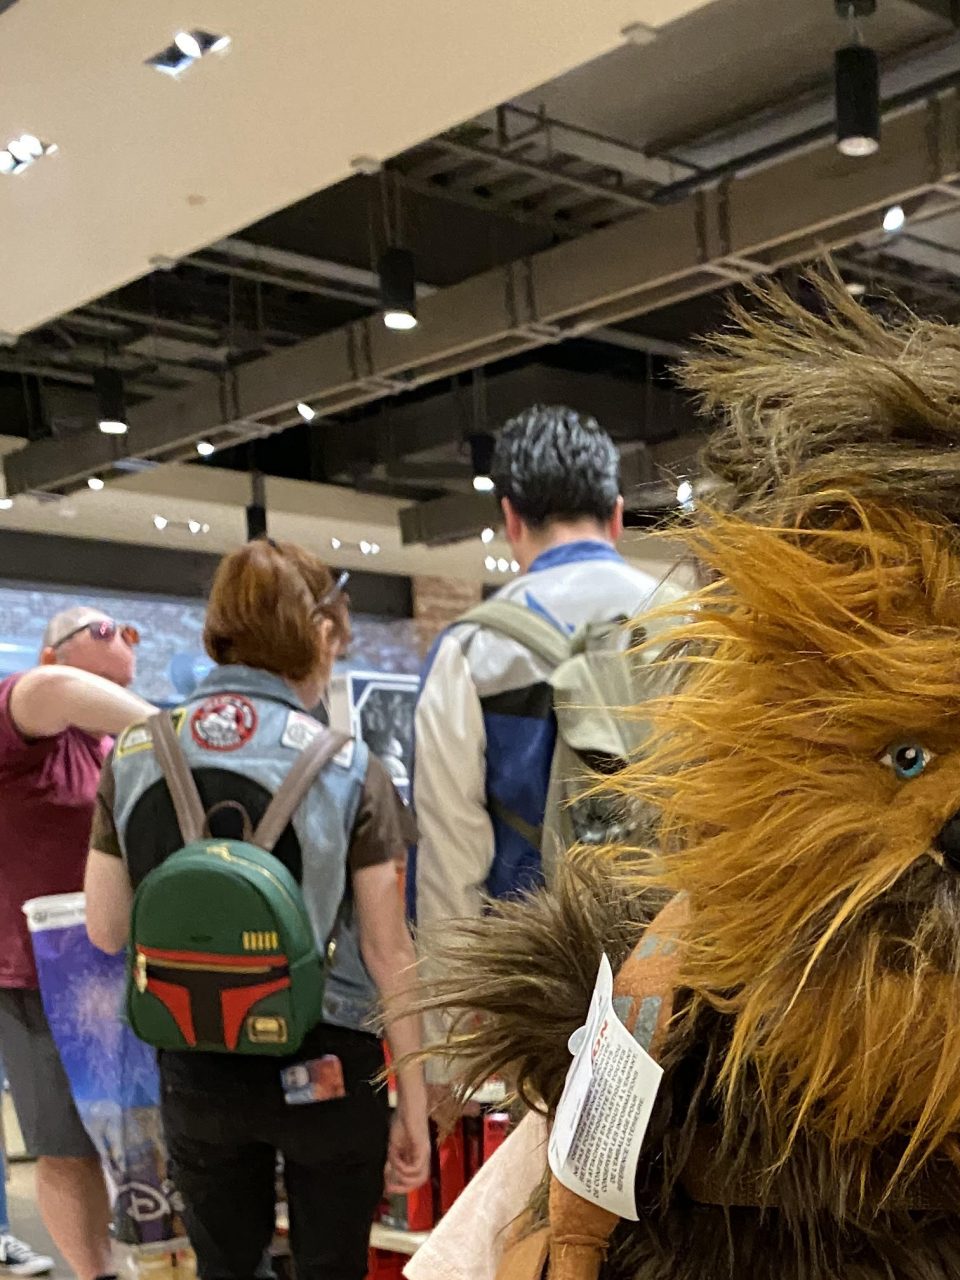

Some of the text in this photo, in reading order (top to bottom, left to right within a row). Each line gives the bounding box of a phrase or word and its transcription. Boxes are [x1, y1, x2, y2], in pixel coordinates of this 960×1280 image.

[575, 1146, 584, 1164] PAS
[580, 1113, 596, 1147] PORTER
[593, 1077, 609, 1113] AUTOUR
[606, 1063, 614, 1078] DU
[610, 1043, 621, 1064] COU
[577, 1146, 592, 1183] RETIRER
[587, 1094, 609, 1147] L'ÉTIQUETTE
[611, 1048, 626, 1081] TOUTES
[587, 1136, 602, 1178] ATTACHES
[603, 1075, 623, 1123] PLASTIQUE
[619, 1047, 633, 1076] AVANT
[592, 1151, 604, 1187] CONFIER
[604, 1100, 621, 1140] PRODUIT
[600, 1069, 639, 1193] CONSERVER LES INFORMATIONS
[610, 1117, 630, 1172] L'EMBALLAGE
[626, 1093, 638, 1118] POUR
